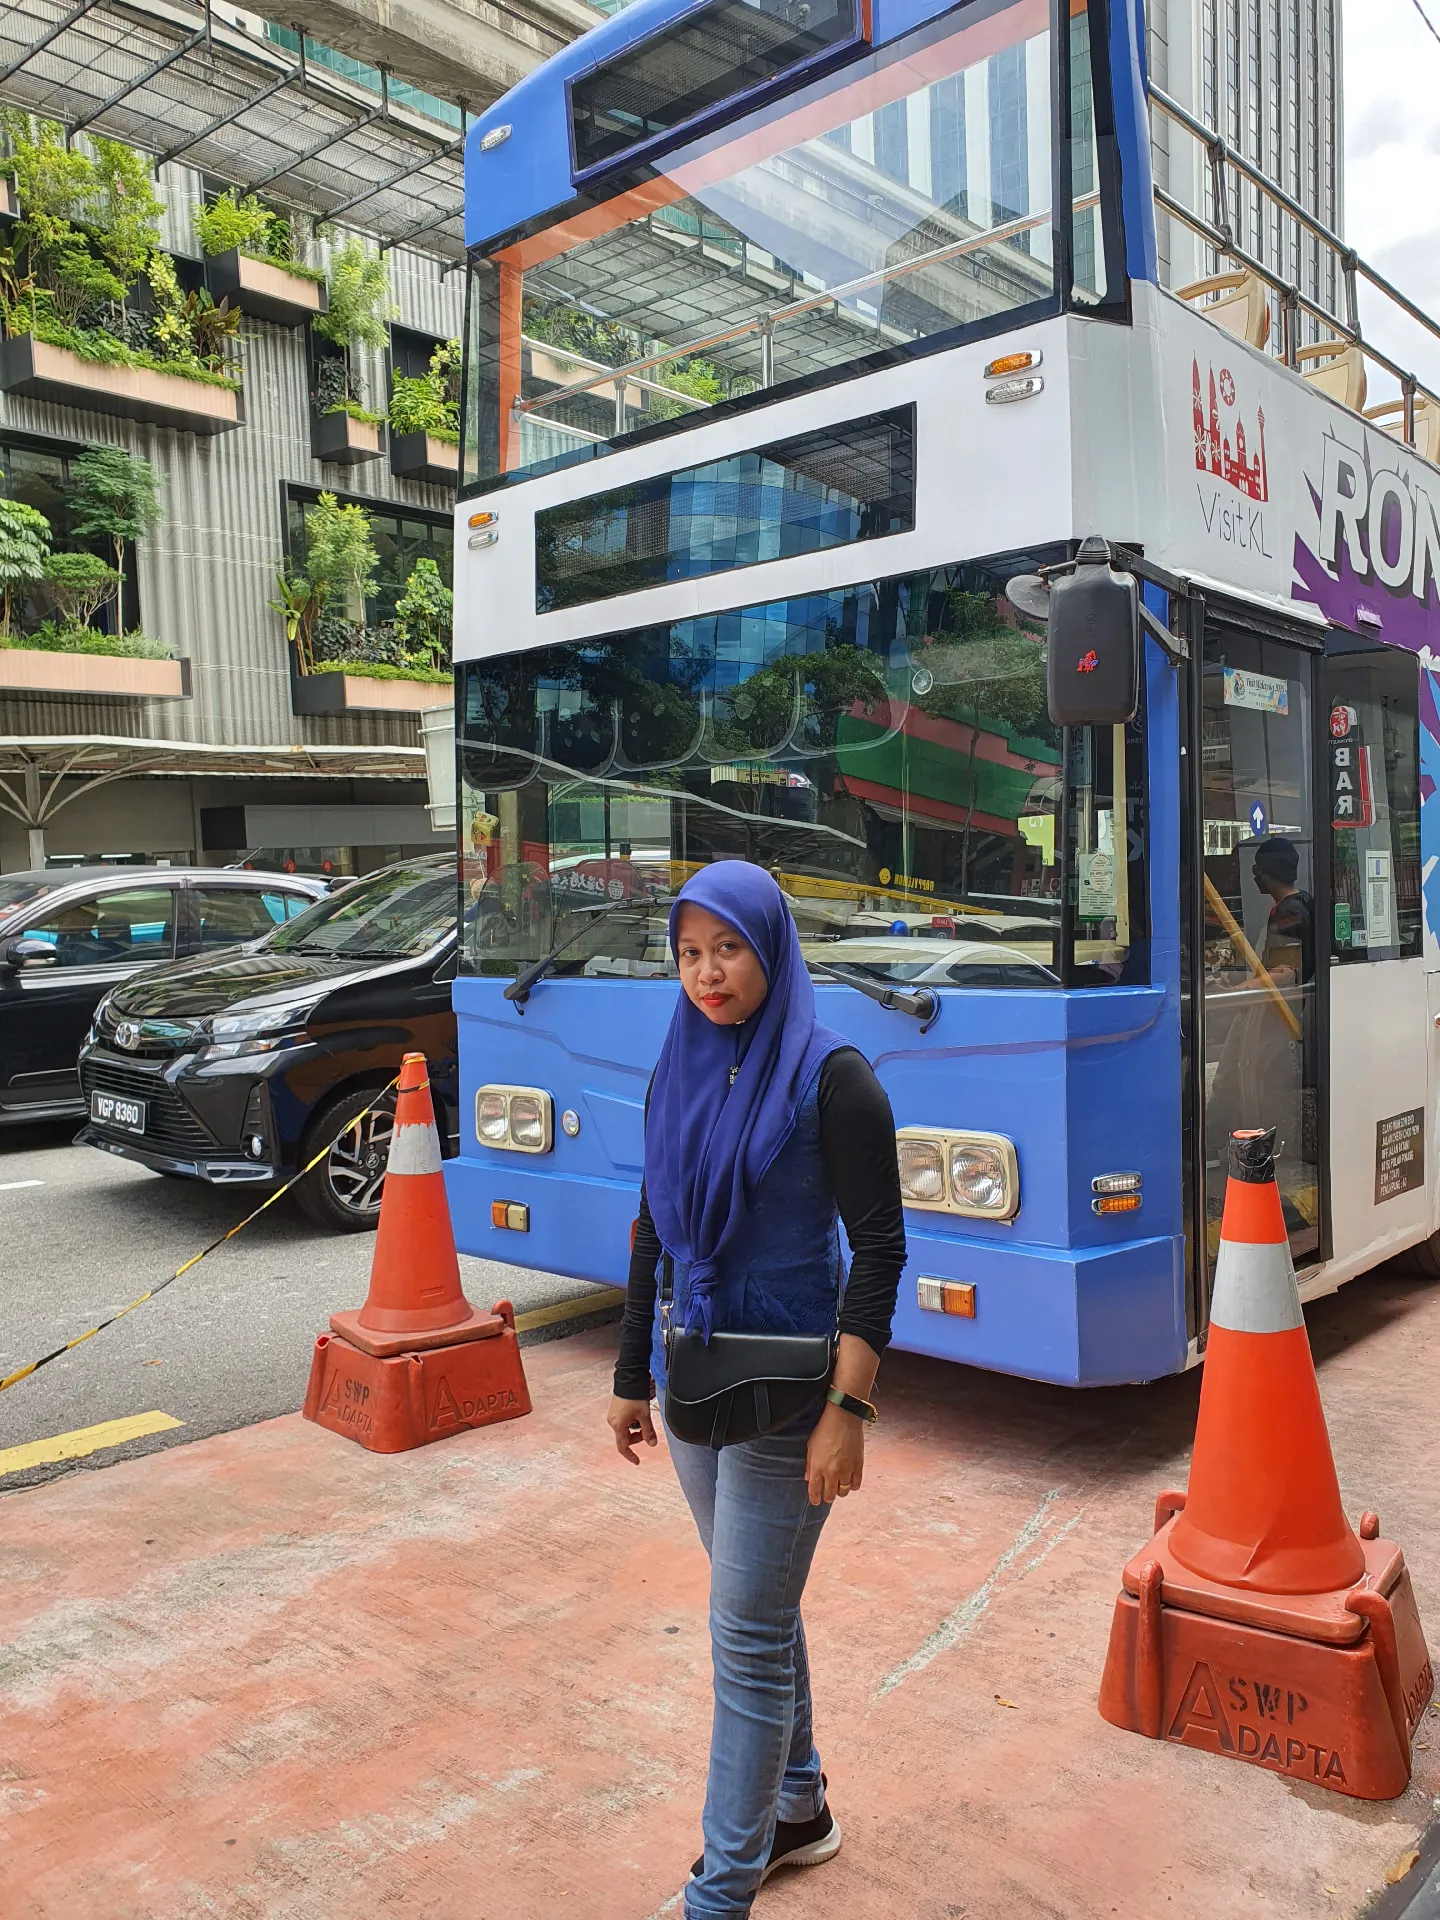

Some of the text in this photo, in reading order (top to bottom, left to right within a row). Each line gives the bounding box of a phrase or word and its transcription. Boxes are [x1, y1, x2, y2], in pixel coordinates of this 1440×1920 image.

[98, 1096, 138, 1124] VGP 8360
[344, 1379, 370, 1406] SWP
[429, 1376, 520, 1430] ADAPTA
[1167, 1660, 1349, 1786] ADAPTA
[1228, 1677, 1309, 1725] SWP
